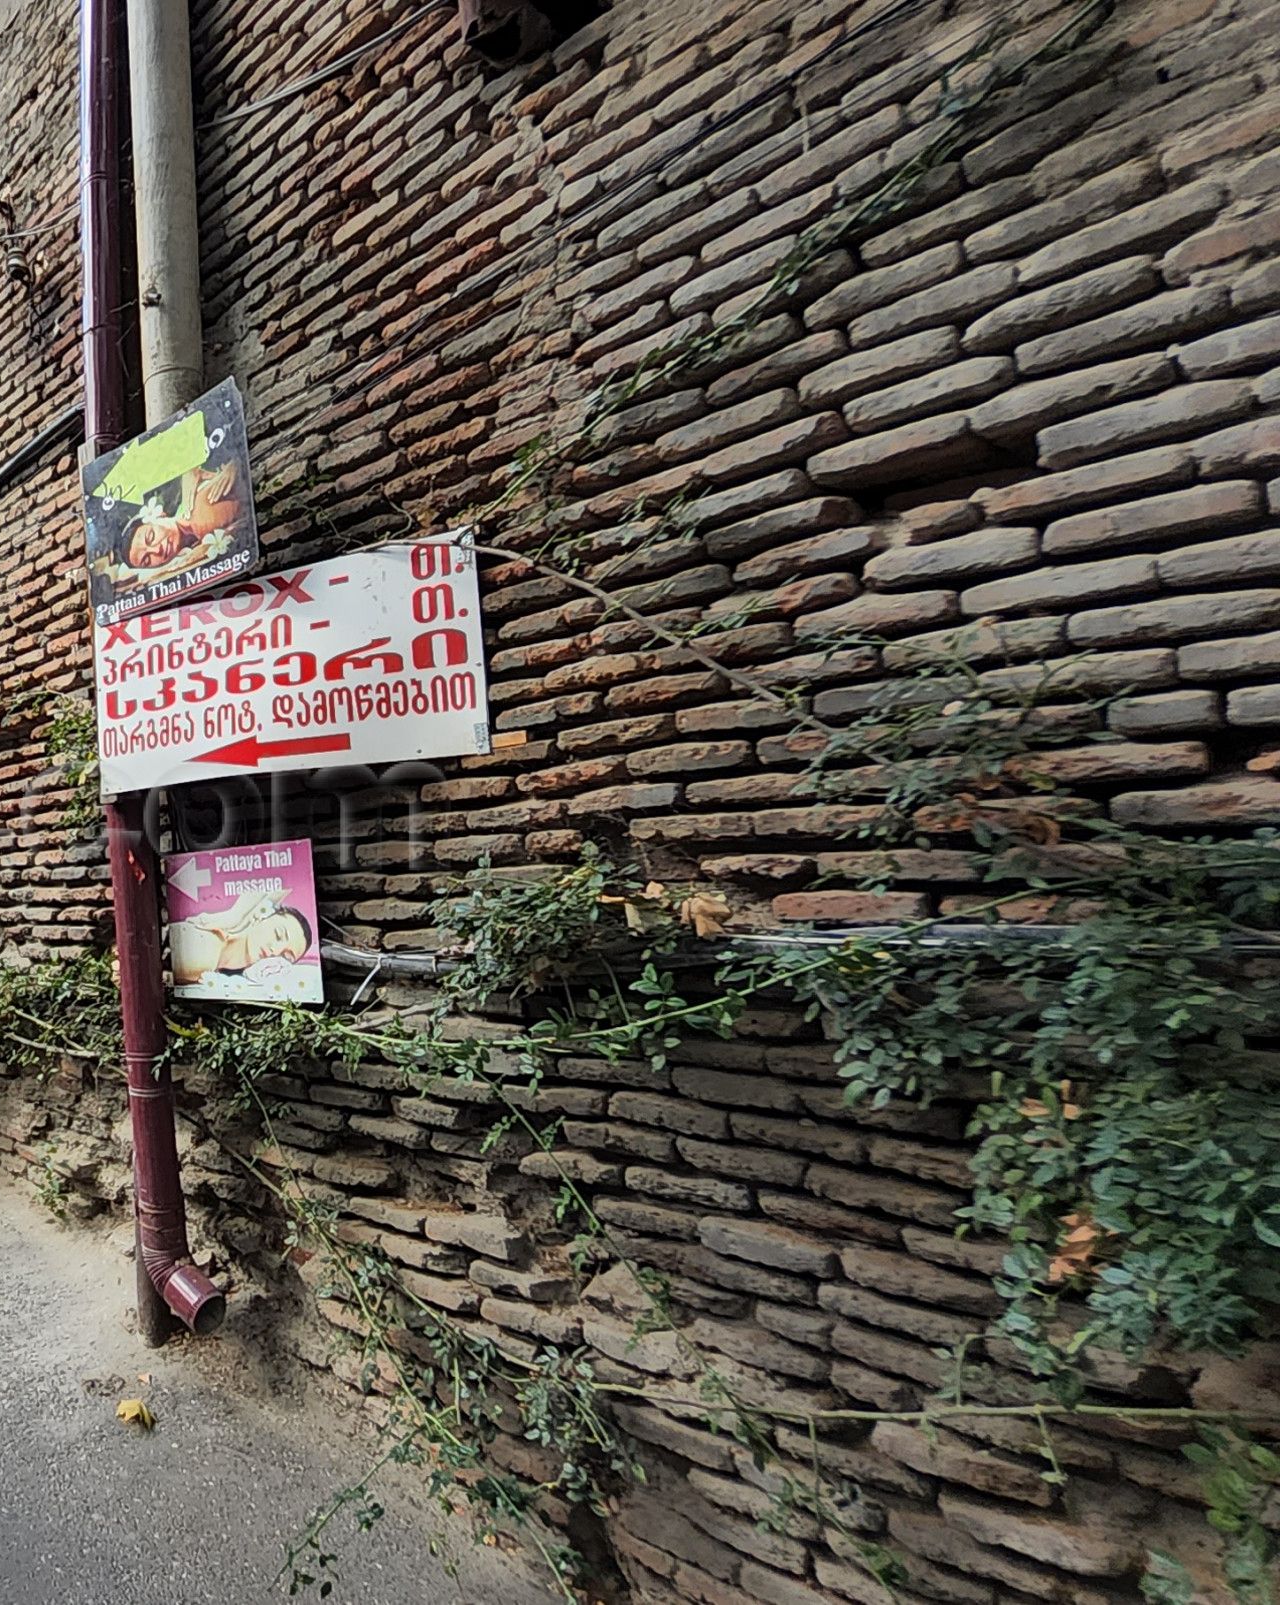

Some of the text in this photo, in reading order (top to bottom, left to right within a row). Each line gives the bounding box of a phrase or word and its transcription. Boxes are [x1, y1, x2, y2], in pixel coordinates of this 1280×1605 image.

[96, 549, 251, 621] Pattaia Thai Massage
[101, 568, 315, 652] XEROX
[102, 613, 293, 686] პრინტერი
[106, 628, 469, 721] სკანერი
[103, 711, 195, 759] თარგმნა
[272, 671, 477, 729] დამოწმებით
[215, 853, 263, 873] Pattaya
[224, 877, 283, 897] massage
